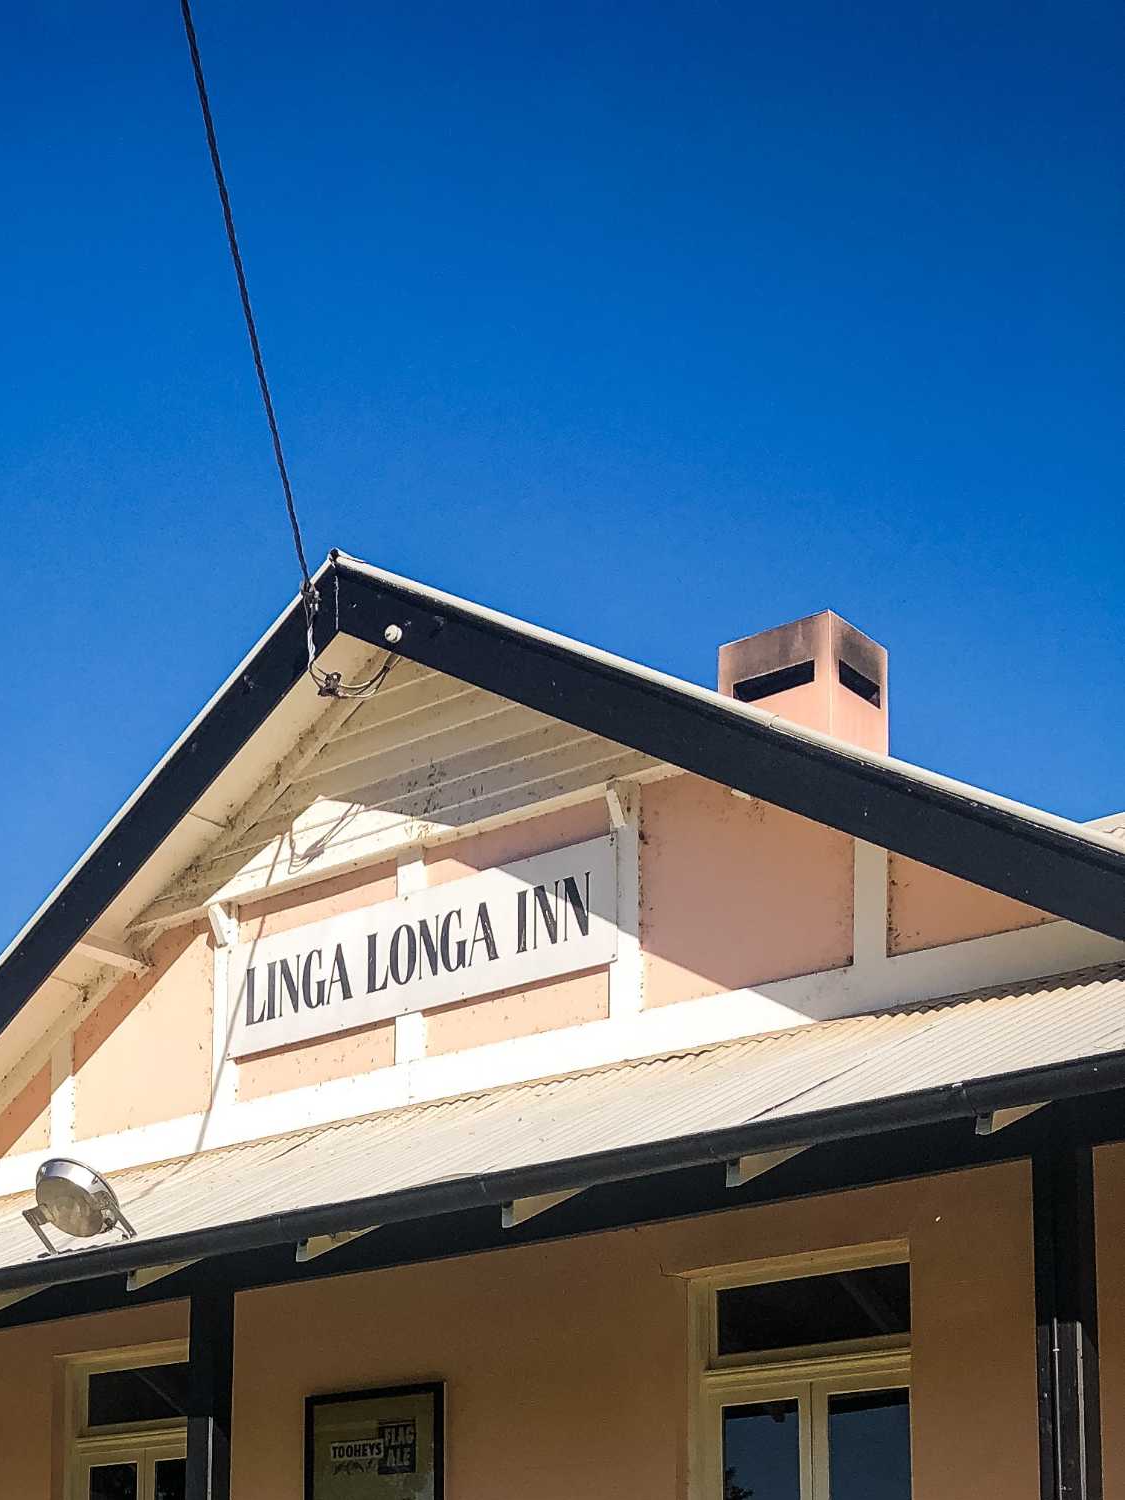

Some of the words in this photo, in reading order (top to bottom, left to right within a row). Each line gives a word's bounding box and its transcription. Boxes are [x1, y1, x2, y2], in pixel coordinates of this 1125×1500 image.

[245, 943, 352, 1026] LINGA
[365, 901, 499, 994] LONGA
[516, 871, 591, 954] INN
[332, 1442, 382, 1459] TOOHEYS
[386, 1447, 411, 1467] ALE
